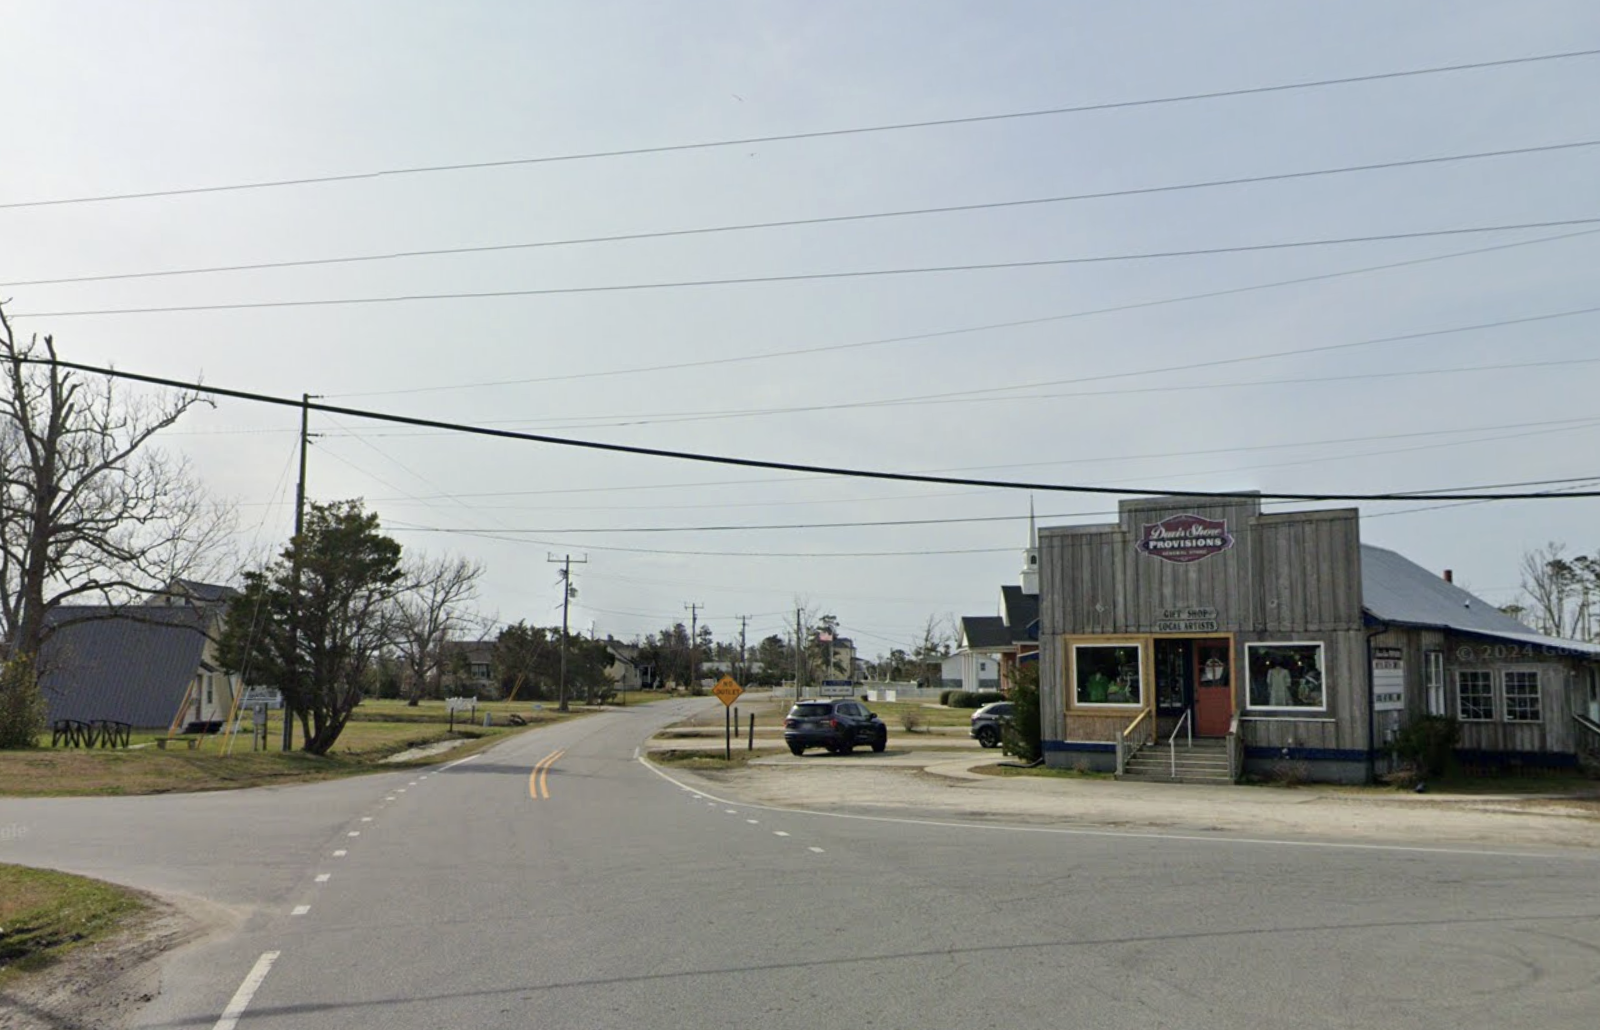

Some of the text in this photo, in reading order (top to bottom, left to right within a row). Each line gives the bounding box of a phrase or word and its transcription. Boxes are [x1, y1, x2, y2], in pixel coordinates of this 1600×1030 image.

[1150, 524, 1222, 539] Davis Shore
[1149, 538, 1222, 549] PROVISIONS
[1163, 609, 1208, 618] GIFT SHOP
[1158, 621, 1215, 631] LOCAL ARTISTS
[723, 680, 733, 688] NO
